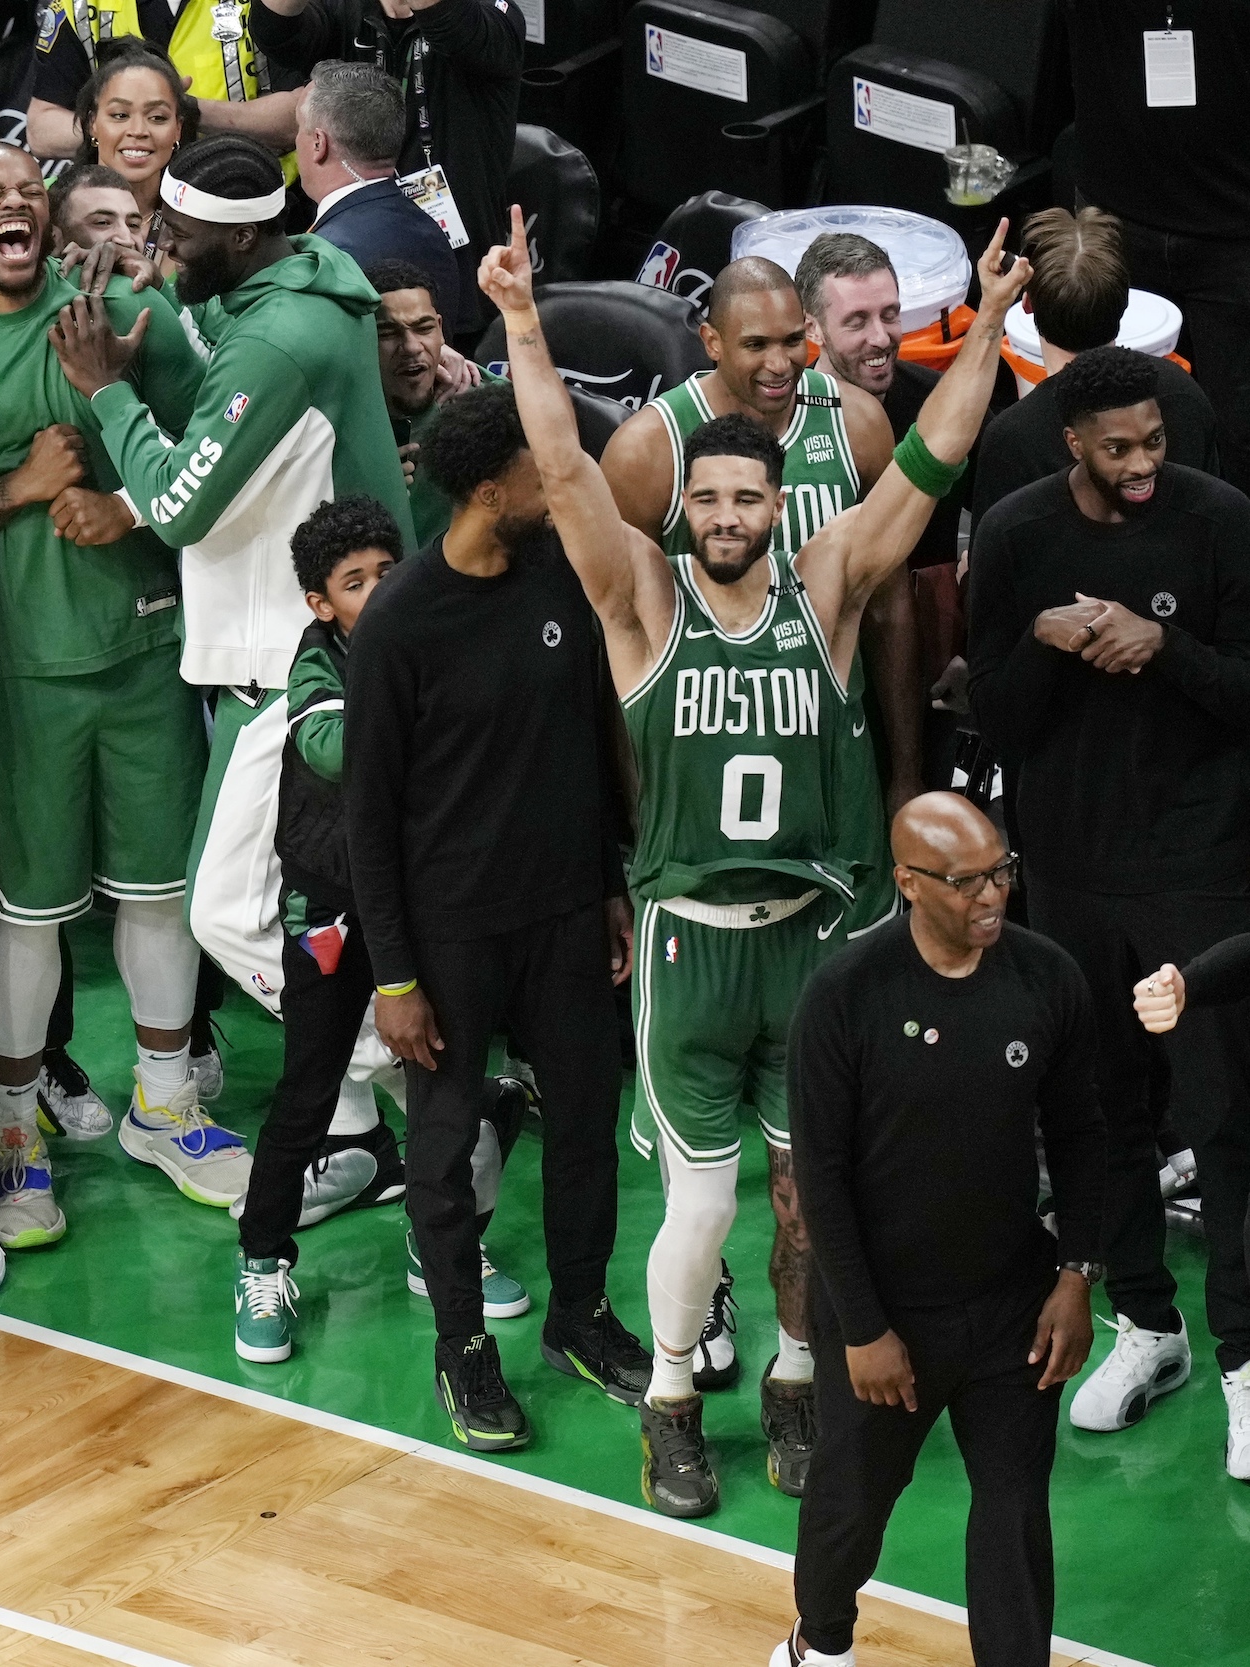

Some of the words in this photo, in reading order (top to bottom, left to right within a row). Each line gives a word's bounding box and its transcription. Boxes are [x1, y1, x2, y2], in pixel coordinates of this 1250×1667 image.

[804, 396, 833, 406] WALTON
[803, 434, 833, 452] VISTA
[806, 449, 834, 464] PRINT
[772, 620, 806, 640] VISTA
[776, 634, 807, 652] PRINT
[674, 666, 819, 737] BOSTON
[720, 755, 783, 841] 0
